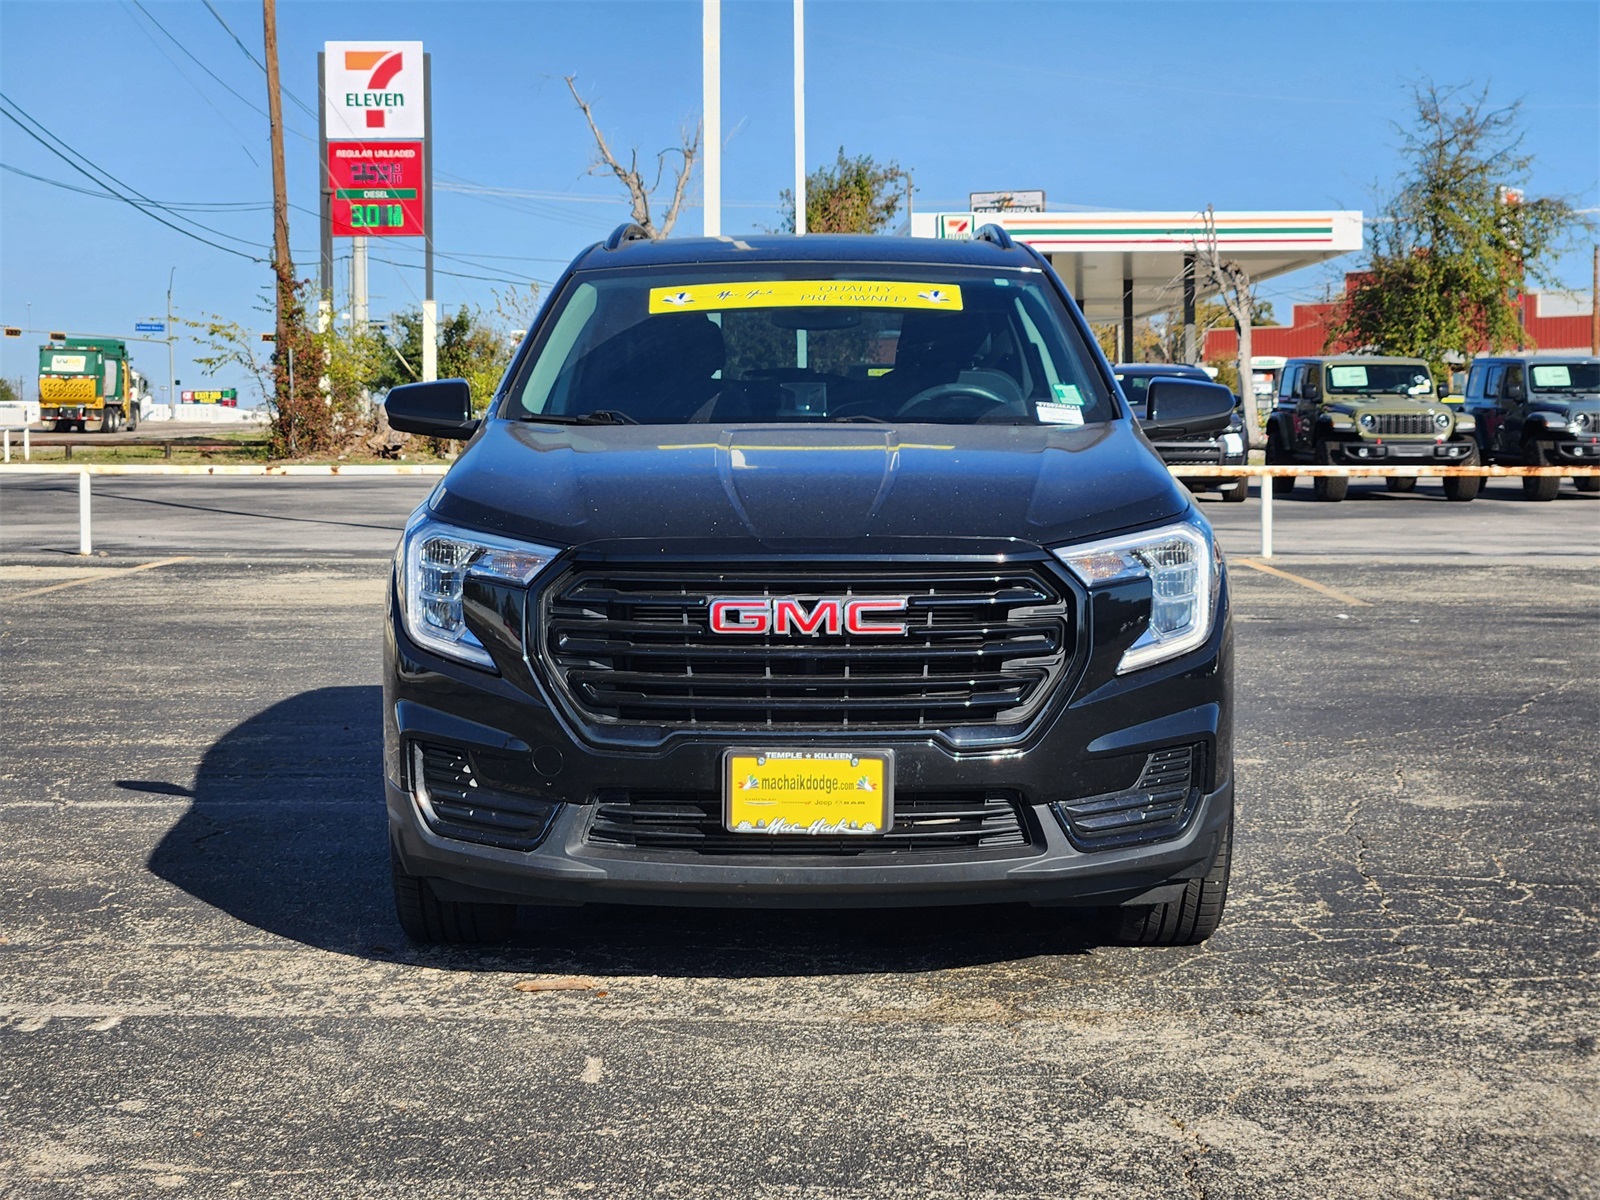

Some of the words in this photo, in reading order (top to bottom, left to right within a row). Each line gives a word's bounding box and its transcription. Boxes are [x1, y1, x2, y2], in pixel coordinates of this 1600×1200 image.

[336, 149, 373, 158] REGULAR
[374, 149, 415, 158] UNLEADED
[363, 190, 389, 199] DIESEL
[709, 597, 908, 636] GMC
[813, 752, 853, 760] KILLEEN
[761, 774, 855, 794] machaikdodge.com
[814, 799, 833, 807] Jeep
[765, 817, 803, 835] Mac
[806, 817, 850, 835] Haik
